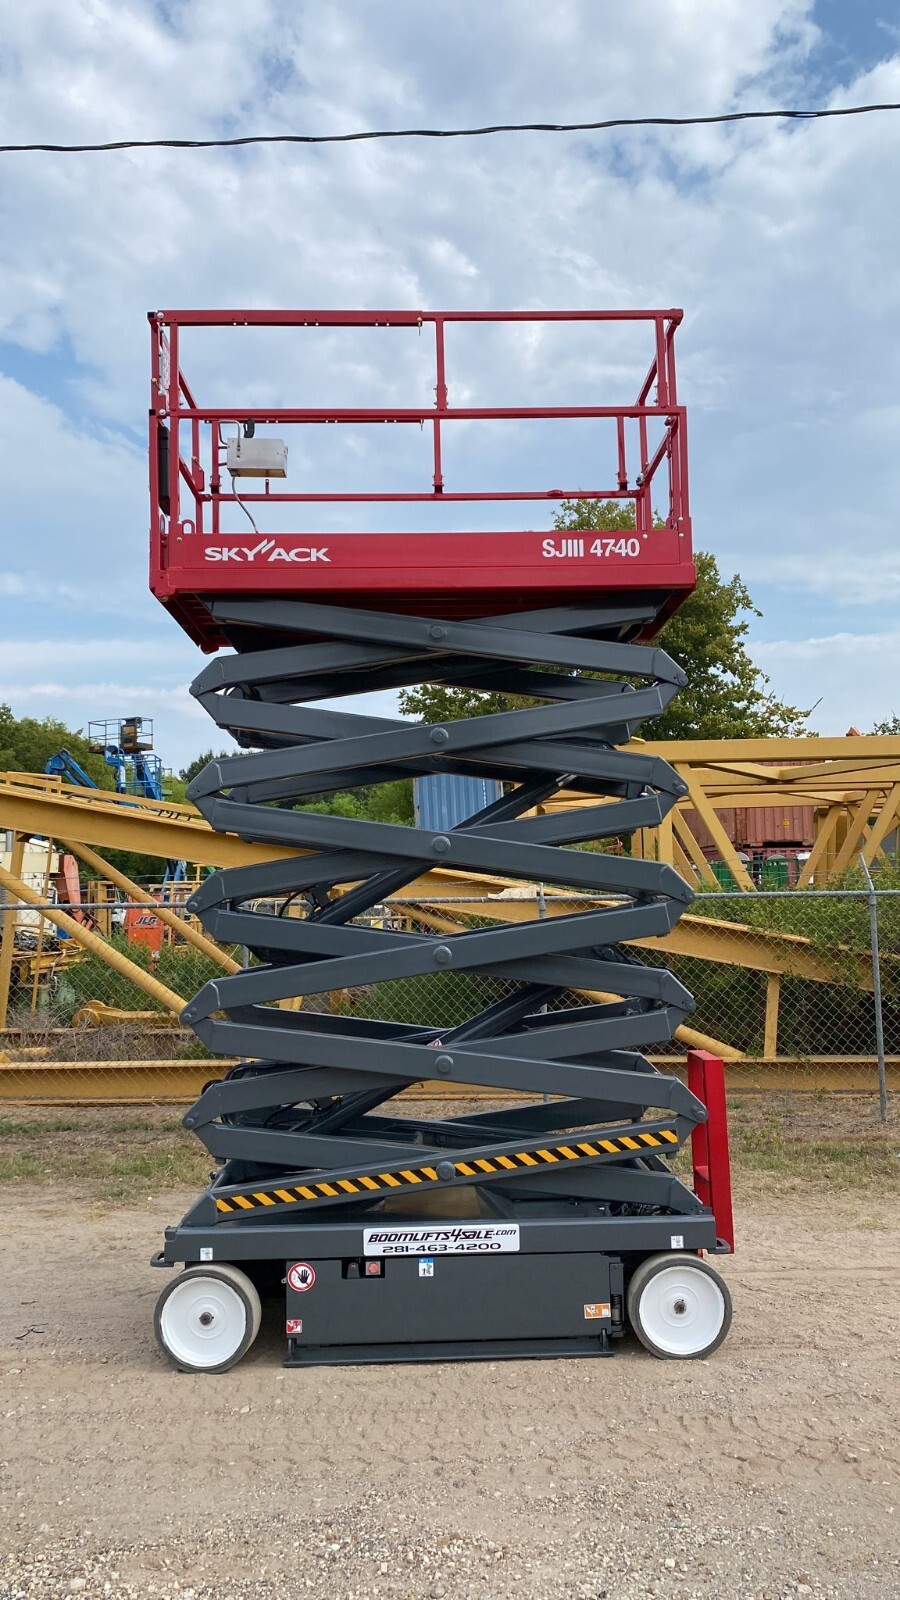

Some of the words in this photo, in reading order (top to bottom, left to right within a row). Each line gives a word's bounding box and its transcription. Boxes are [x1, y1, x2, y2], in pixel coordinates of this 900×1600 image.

[590, 538, 640, 557] 4740
[135, 916, 158, 925] JLG
[382, 1242, 502, 1254] 281-463-4200
